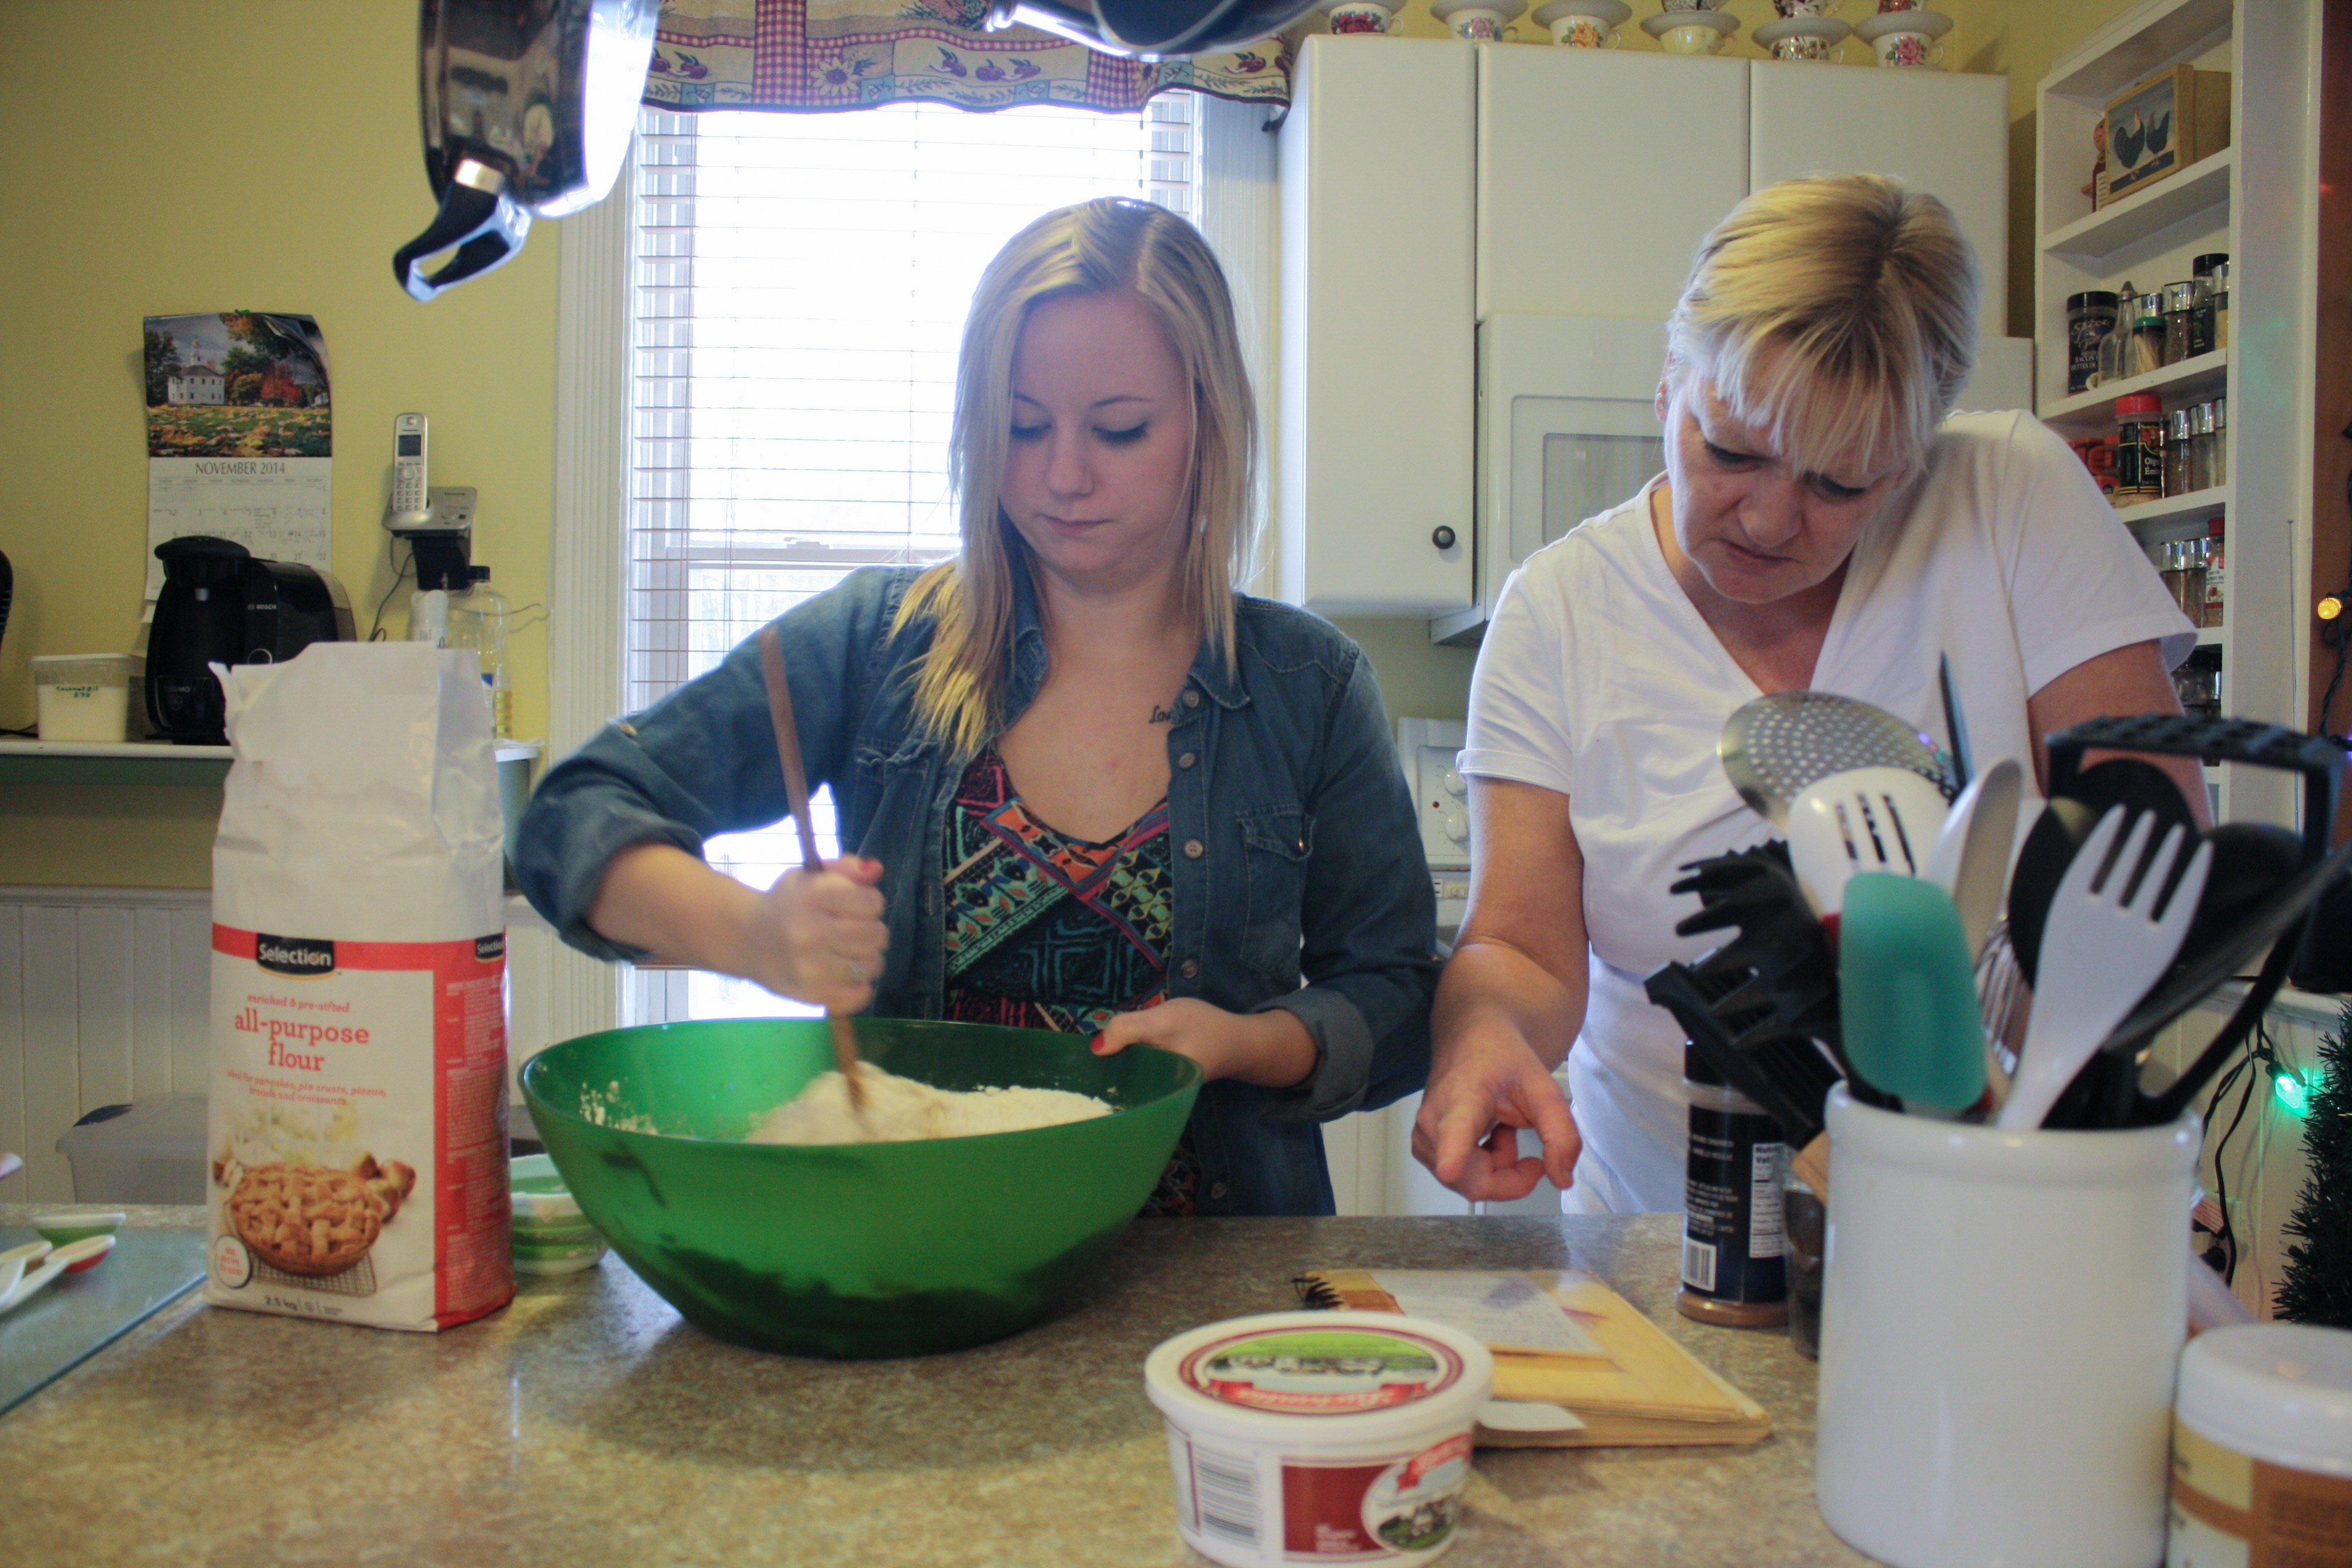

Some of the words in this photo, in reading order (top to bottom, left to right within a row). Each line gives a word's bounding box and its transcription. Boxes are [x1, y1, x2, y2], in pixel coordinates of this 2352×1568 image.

[195, 462, 256, 474] NOVEMBER
[260, 462, 285, 474] 2014
[259, 942, 332, 966] Selection
[247, 994, 287, 1006] enriched
[298, 1000, 351, 1013] pre-sifted
[235, 1007, 370, 1046] all-purpose
[269, 1042, 325, 1071] flour
